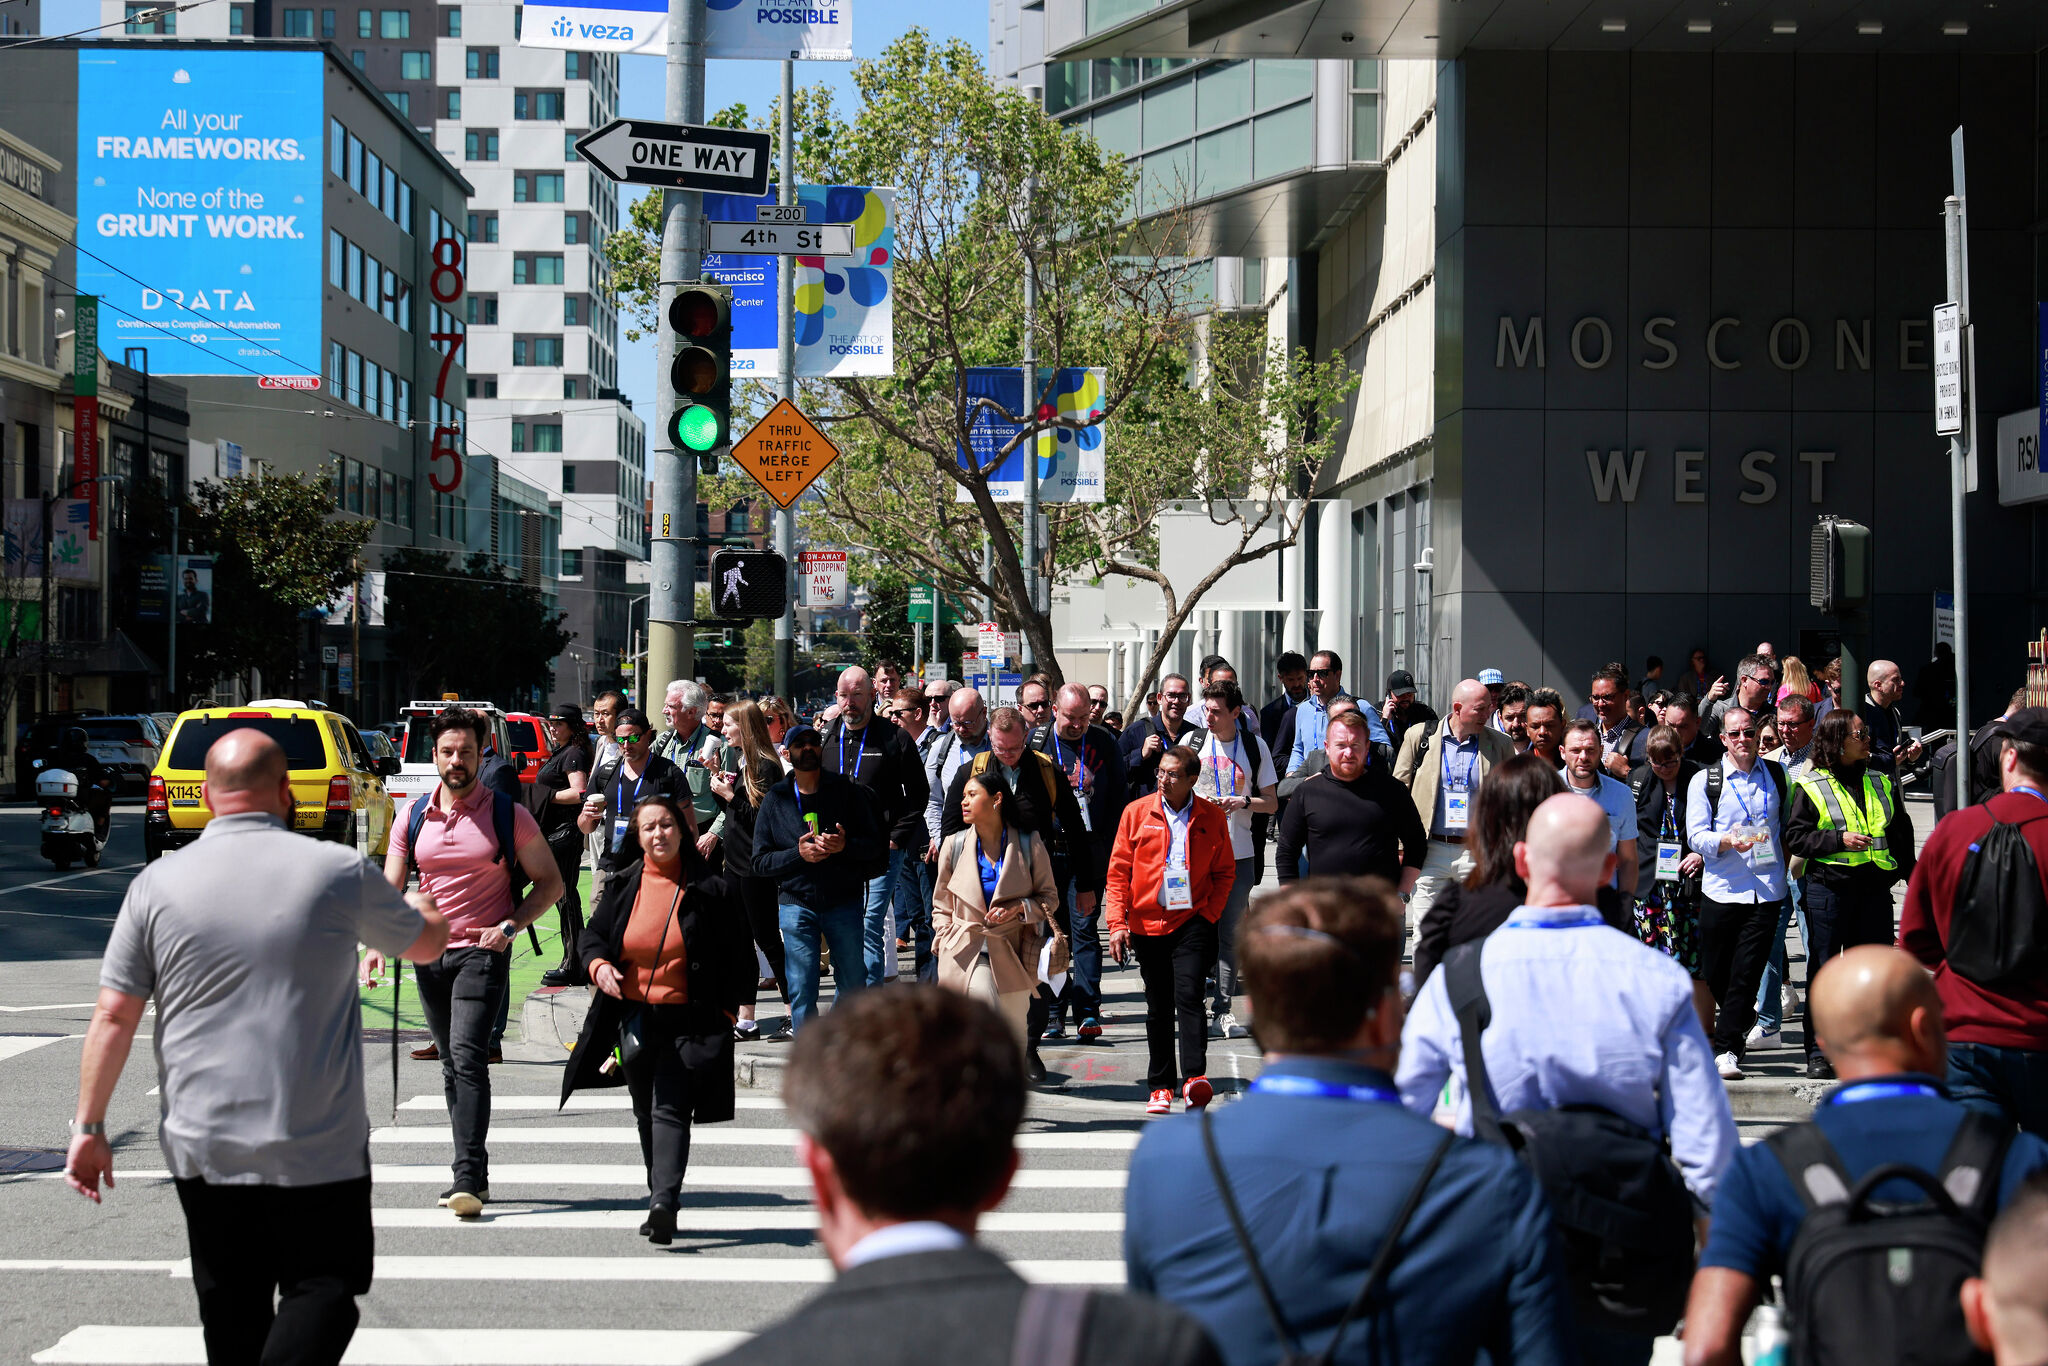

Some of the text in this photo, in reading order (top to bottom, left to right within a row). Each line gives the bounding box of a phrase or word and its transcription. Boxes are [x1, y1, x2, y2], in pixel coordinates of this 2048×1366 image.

[757, 9, 838, 24] POSSIBLE
[579, 24, 634, 41] veza
[160, 108, 243, 135] All your
[97, 136, 306, 161] FRAMEWORKS.
[632, 142, 747, 173] ONE WAY
[0, 148, 42, 196] OMPUTER
[138, 187, 264, 210] None of the
[774, 208, 800, 220] 200
[96, 214, 304, 239] GRUNT WORK.
[740, 229, 822, 249] 4th St
[714, 272, 764, 282] Francisco
[142, 289, 256, 311] DRATA
[734, 298, 764, 306] Center
[116, 320, 280, 330] Continuous Compliance Automation
[829, 335, 884, 344] THE ART OF
[1496, 316, 1928, 370] MOSCONE
[238, 348, 280, 356] drata.com
[829, 346, 884, 355] POSSIBLE
[730, 359, 755, 370] eza
[274, 378, 314, 387] CAPITOL
[769, 425, 801, 436] THRU
[758, 440, 812, 451] TRAFFIC
[760, 456, 810, 466] MERGE
[766, 471, 803, 481] LEFT
[1586, 450, 1836, 504] WEST
[800, 561, 844, 573] NO STOPPING
[814, 575, 831, 584] ANY
[812, 586, 832, 595] TIME
[168, 786, 202, 798] K1143
